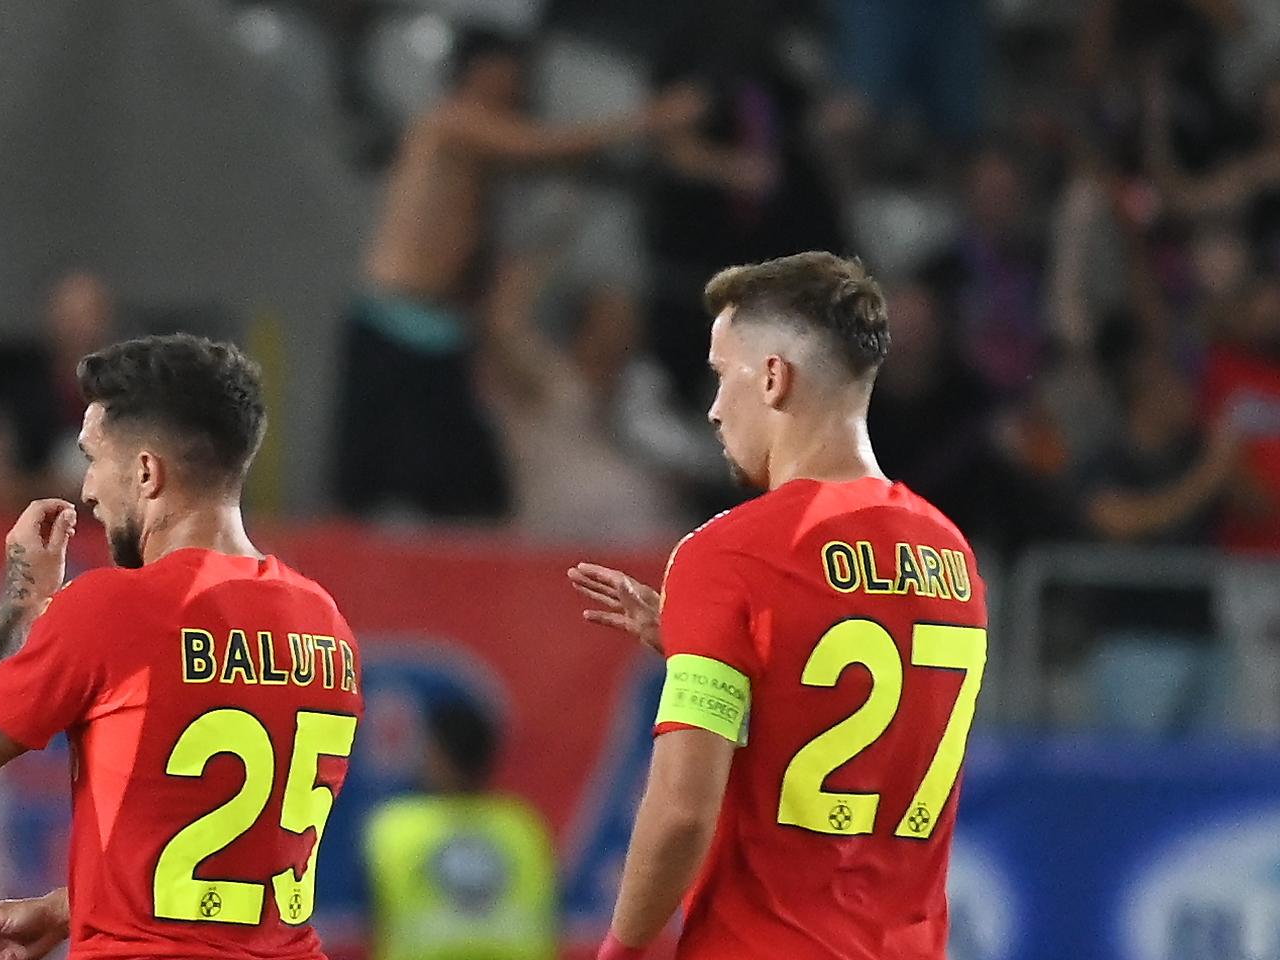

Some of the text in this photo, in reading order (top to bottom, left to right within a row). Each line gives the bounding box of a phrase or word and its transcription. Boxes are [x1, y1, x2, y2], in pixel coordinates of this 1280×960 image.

[821, 540, 972, 602] OLARU
[180, 627, 358, 695] BALUTA
[776, 617, 988, 839] 27
[152, 708, 358, 926] 25
